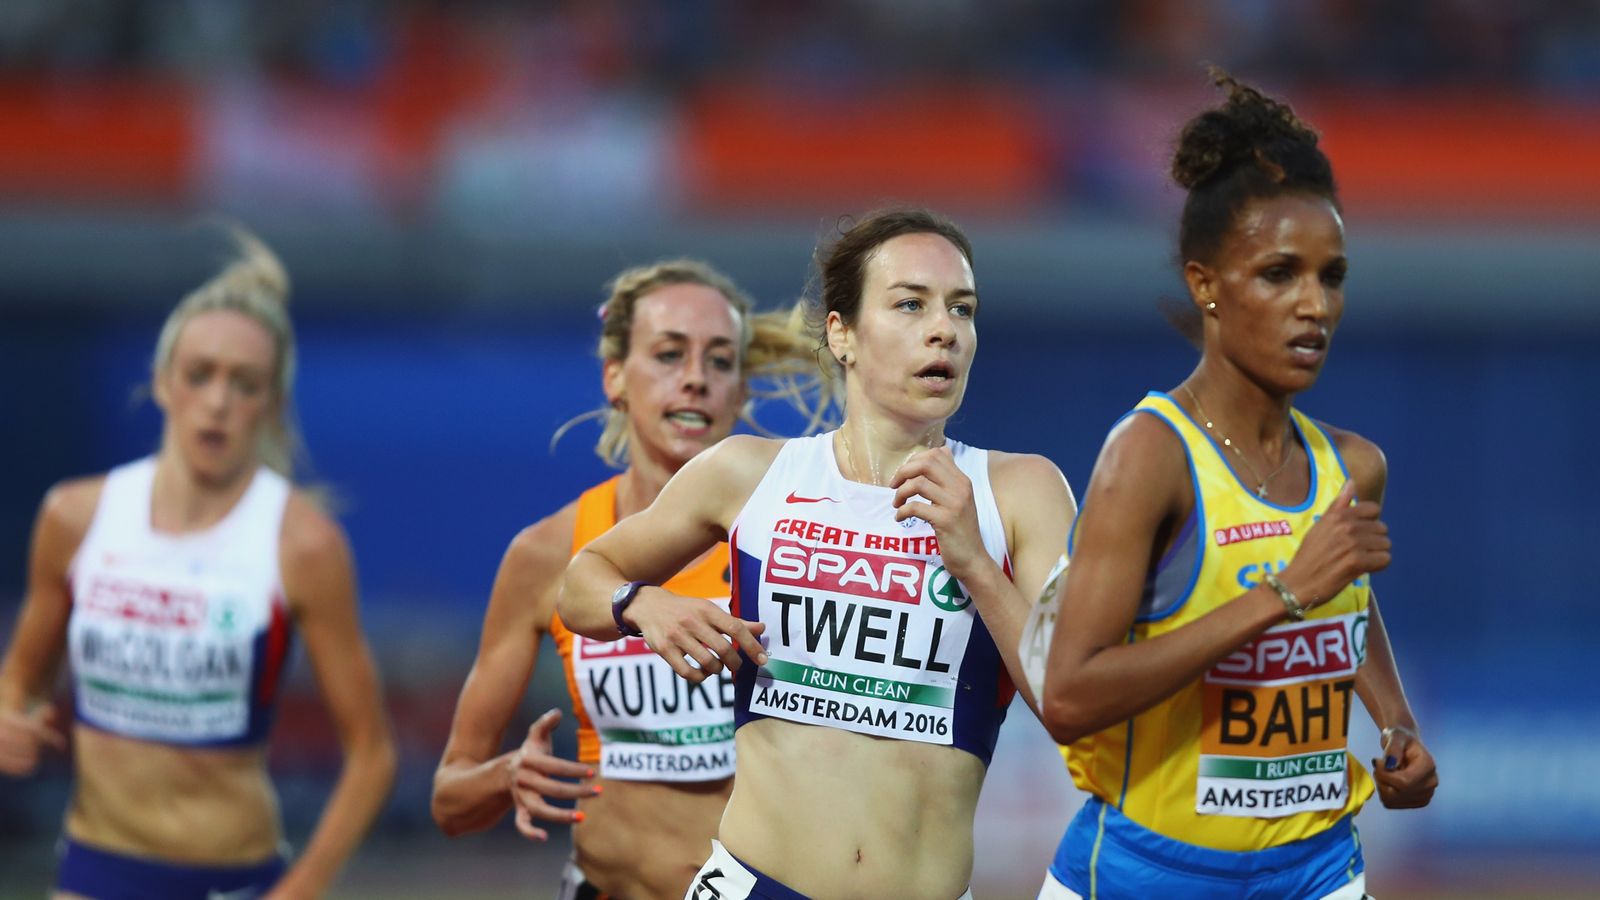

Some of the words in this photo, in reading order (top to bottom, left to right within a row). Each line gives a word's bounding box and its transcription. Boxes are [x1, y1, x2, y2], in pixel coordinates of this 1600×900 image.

[774, 519, 859, 547] GREAT
[1215, 521, 1291, 545] BAUHAUS
[771, 545, 921, 597] SPAR
[771, 591, 951, 673] TWELL
[1216, 629, 1348, 673] SPAR
[801, 668, 808, 683] I
[811, 670, 848, 690] RUN
[852, 678, 911, 700] CLEAN
[755, 686, 897, 730] AMSTERDAM
[902, 711, 948, 736] 2016
[1219, 679, 1355, 747] BAHT
[606, 751, 730, 772] AMSTERDAM
[1255, 762, 1261, 778] I
[1266, 760, 1301, 778] RUN
